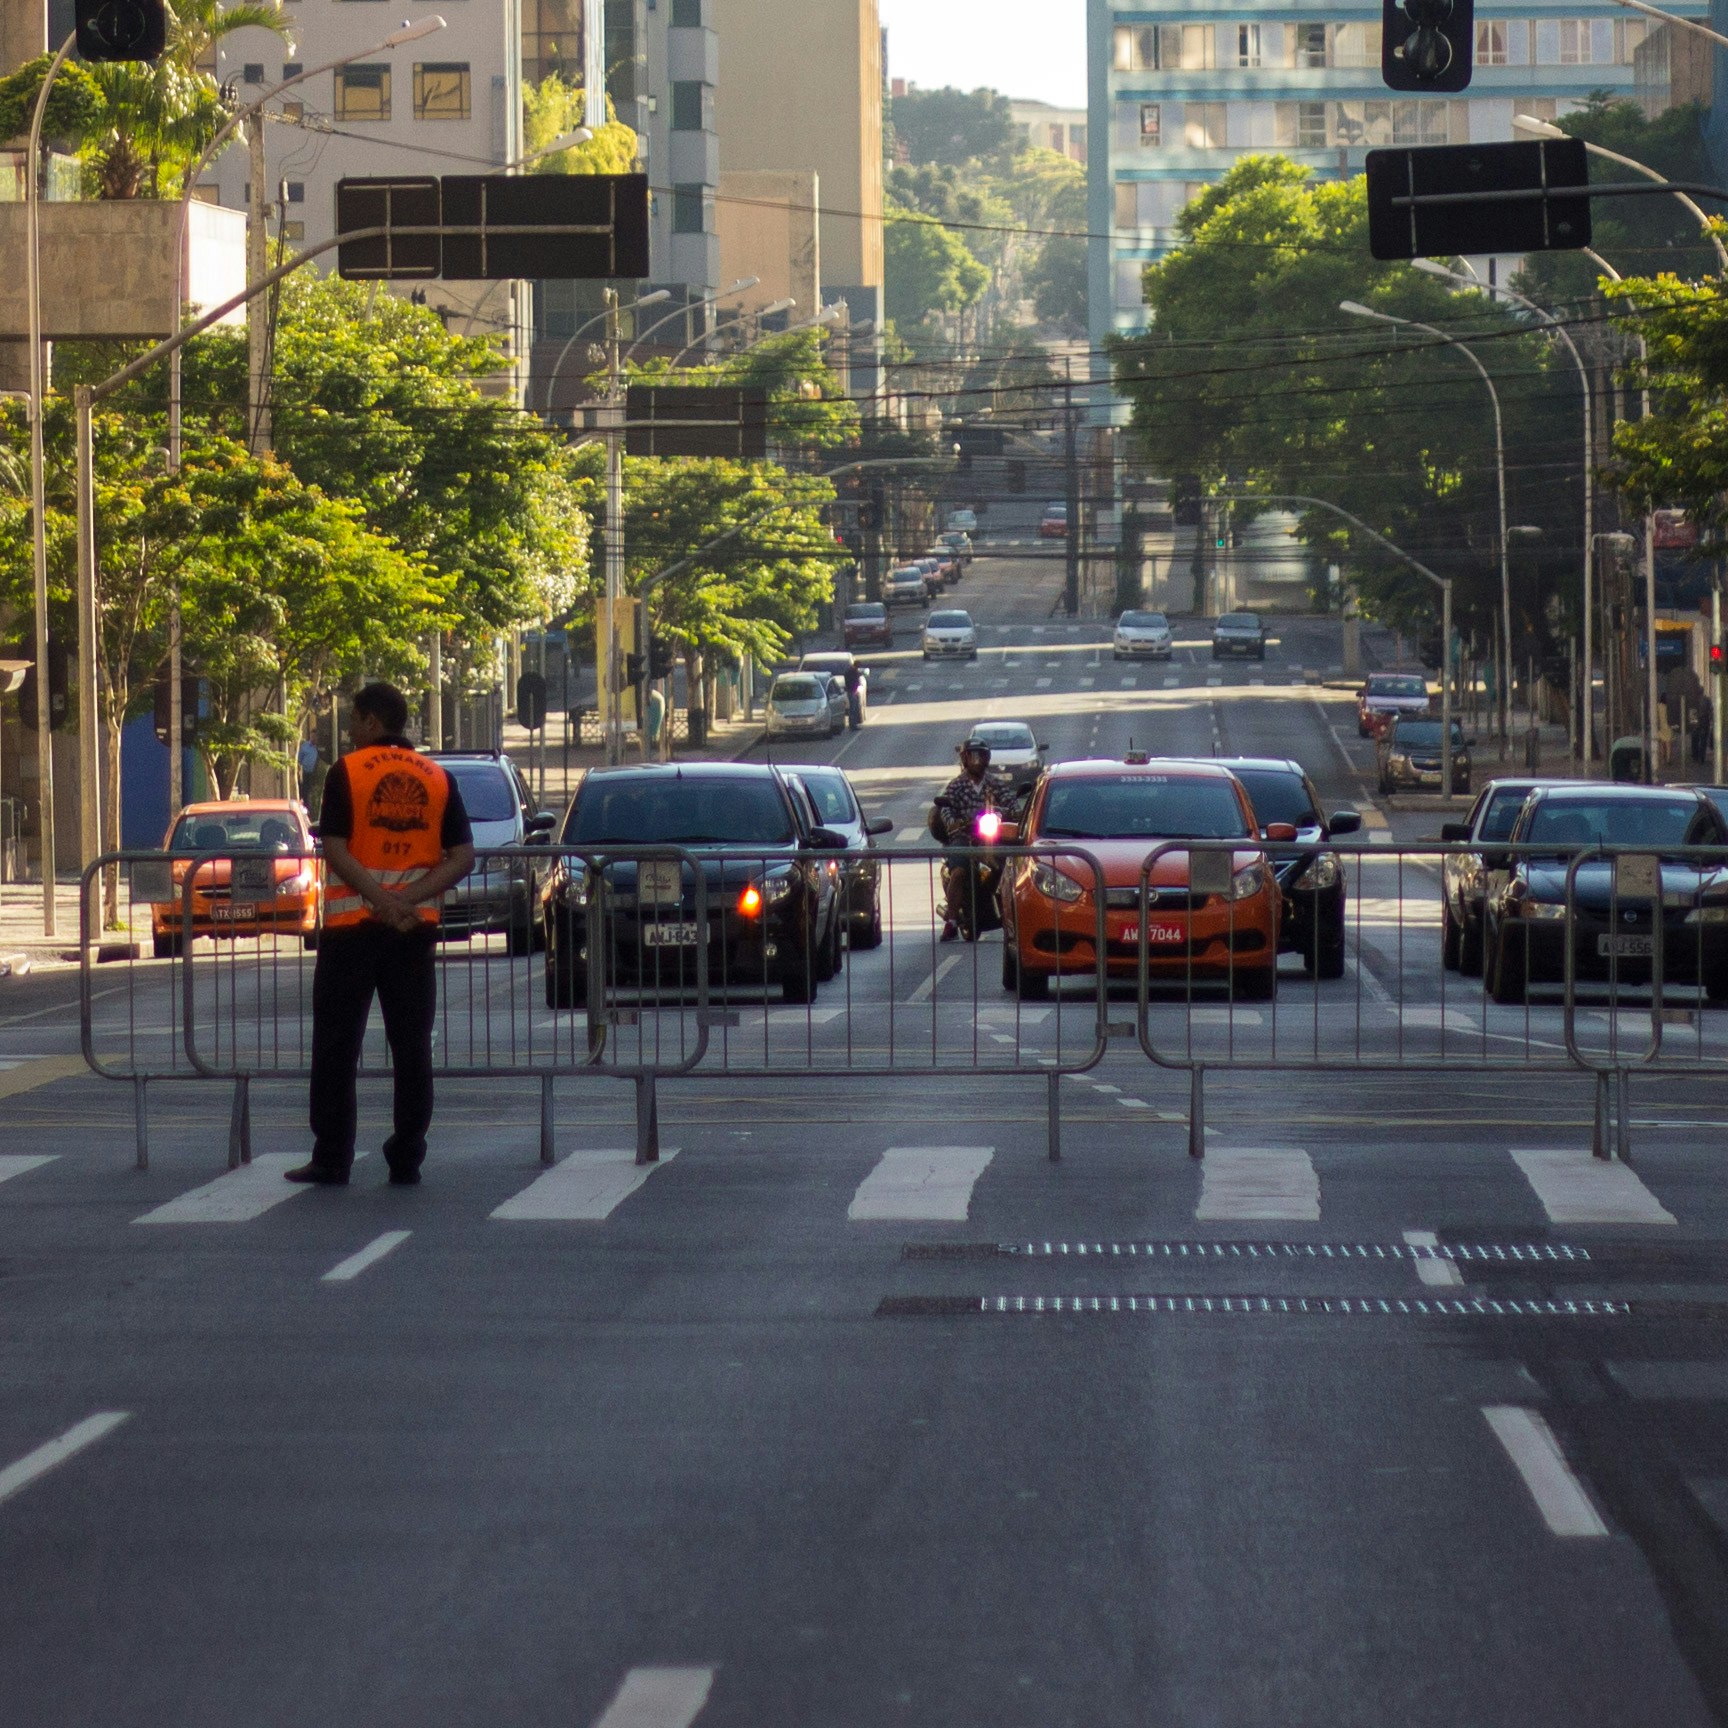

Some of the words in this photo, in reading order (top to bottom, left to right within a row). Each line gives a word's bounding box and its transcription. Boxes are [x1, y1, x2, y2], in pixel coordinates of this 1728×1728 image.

[364, 752, 434, 776] STEWARD
[384, 841, 412, 855] 017
[1150, 928, 1181, 940] 7044
